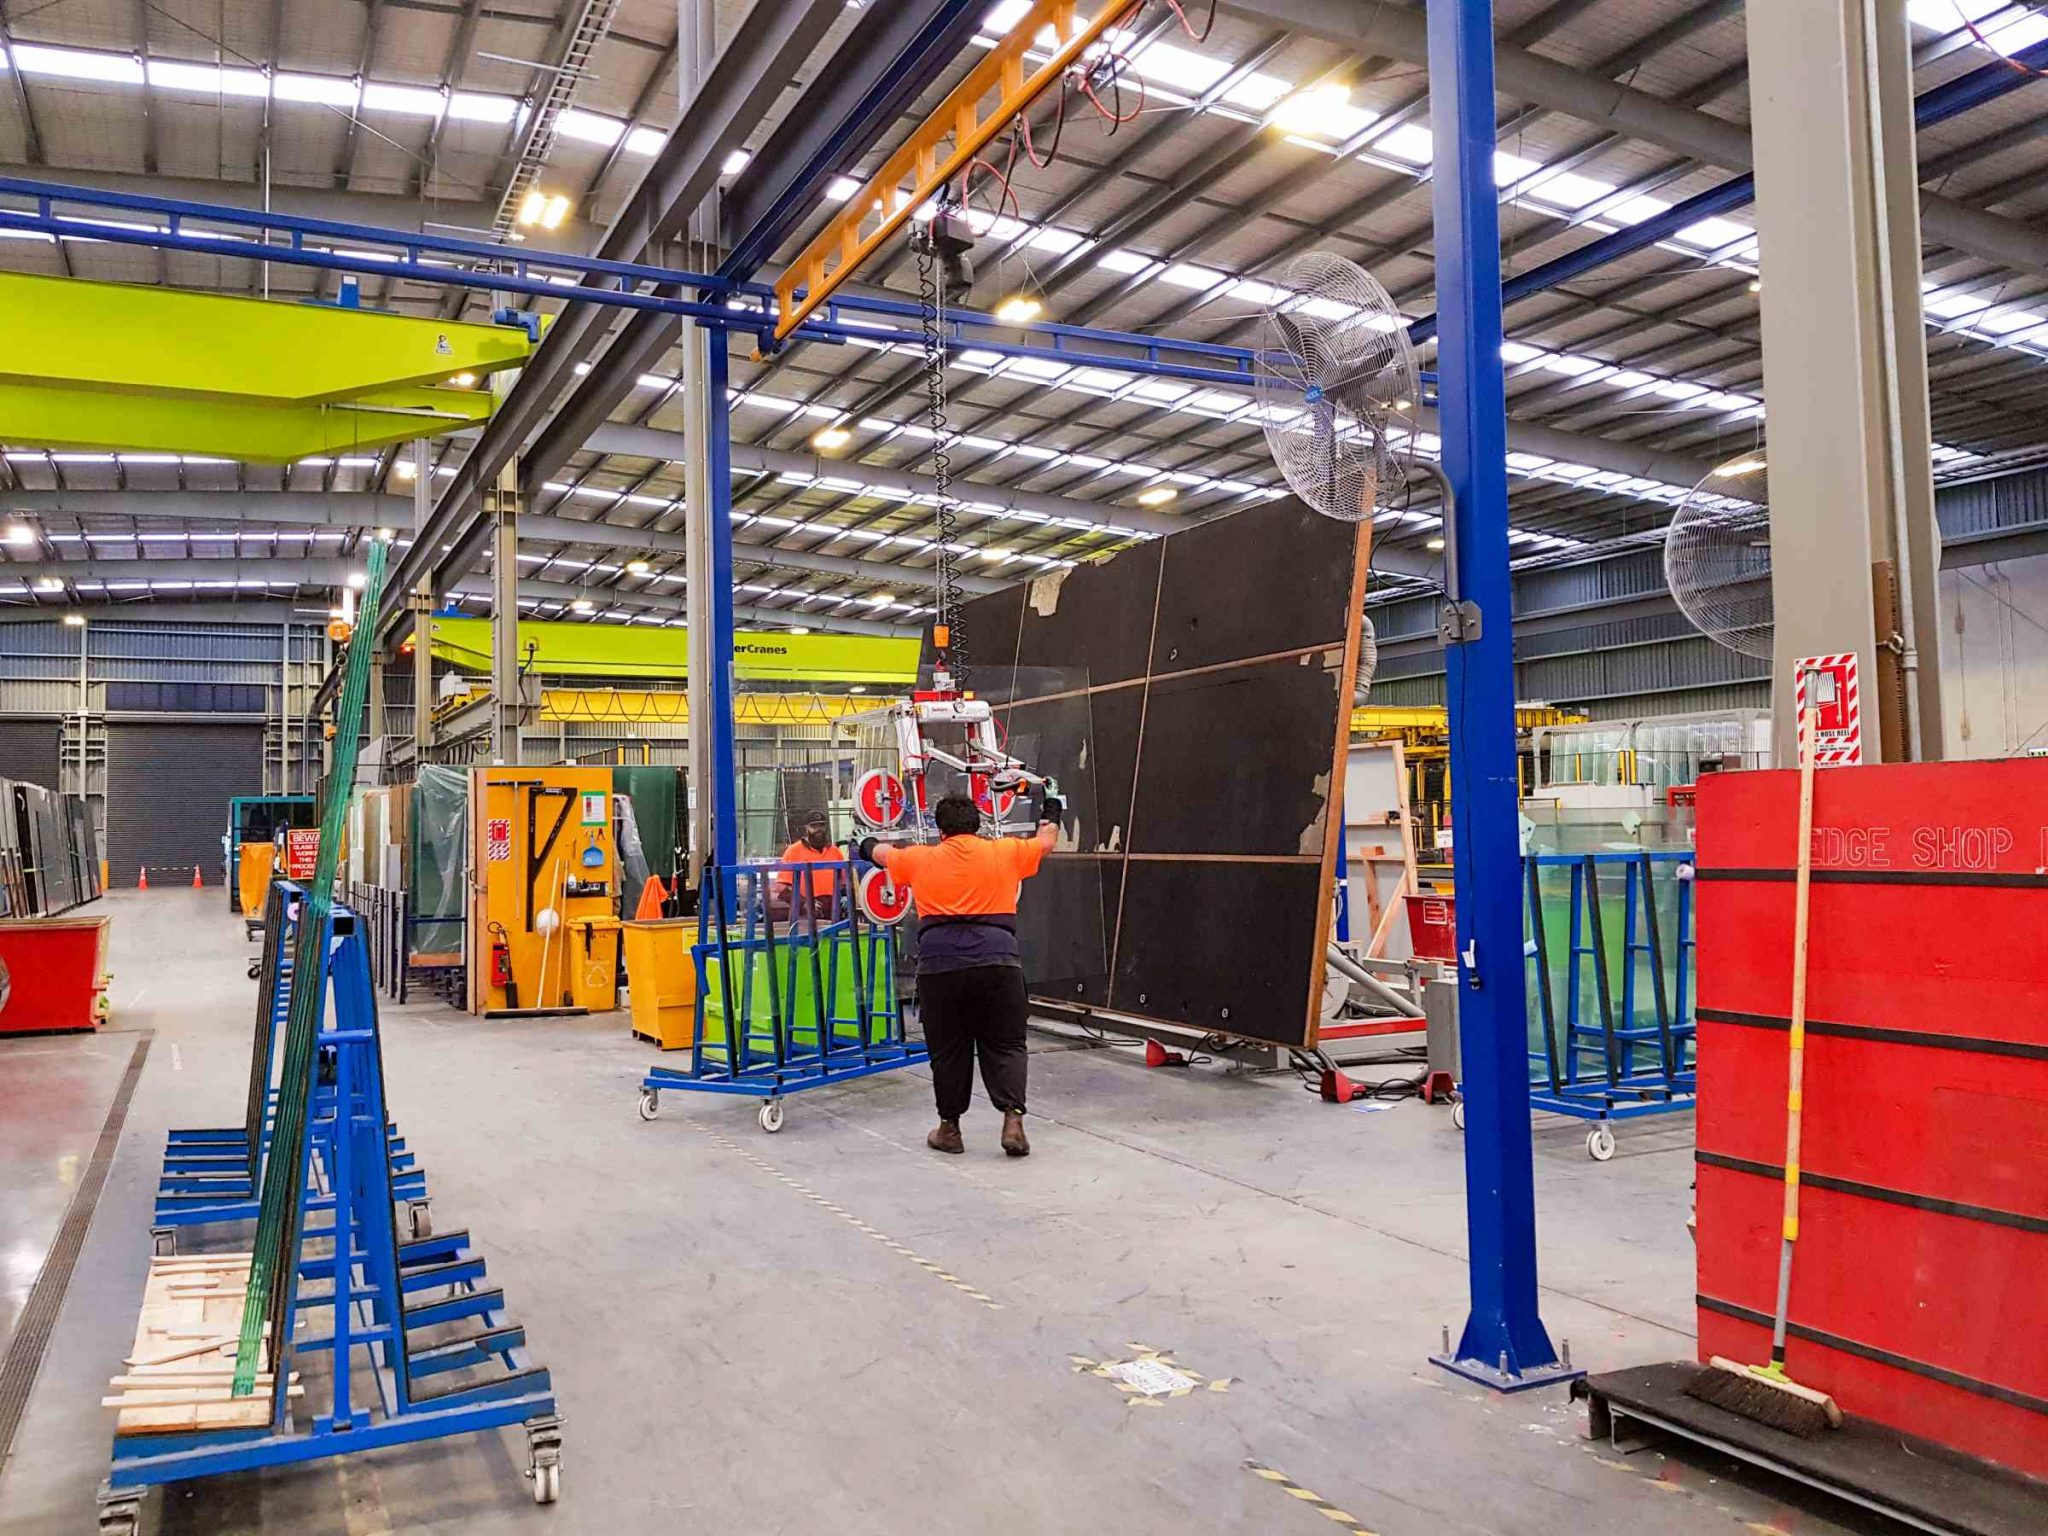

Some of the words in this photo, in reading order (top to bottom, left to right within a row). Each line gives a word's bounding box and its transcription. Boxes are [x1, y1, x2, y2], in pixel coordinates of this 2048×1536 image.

[734, 644, 788, 655] erCranes
[1820, 730, 1836, 738] HOSE
[293, 832, 320, 842] BEWA
[1912, 826, 2013, 868] SHOP
